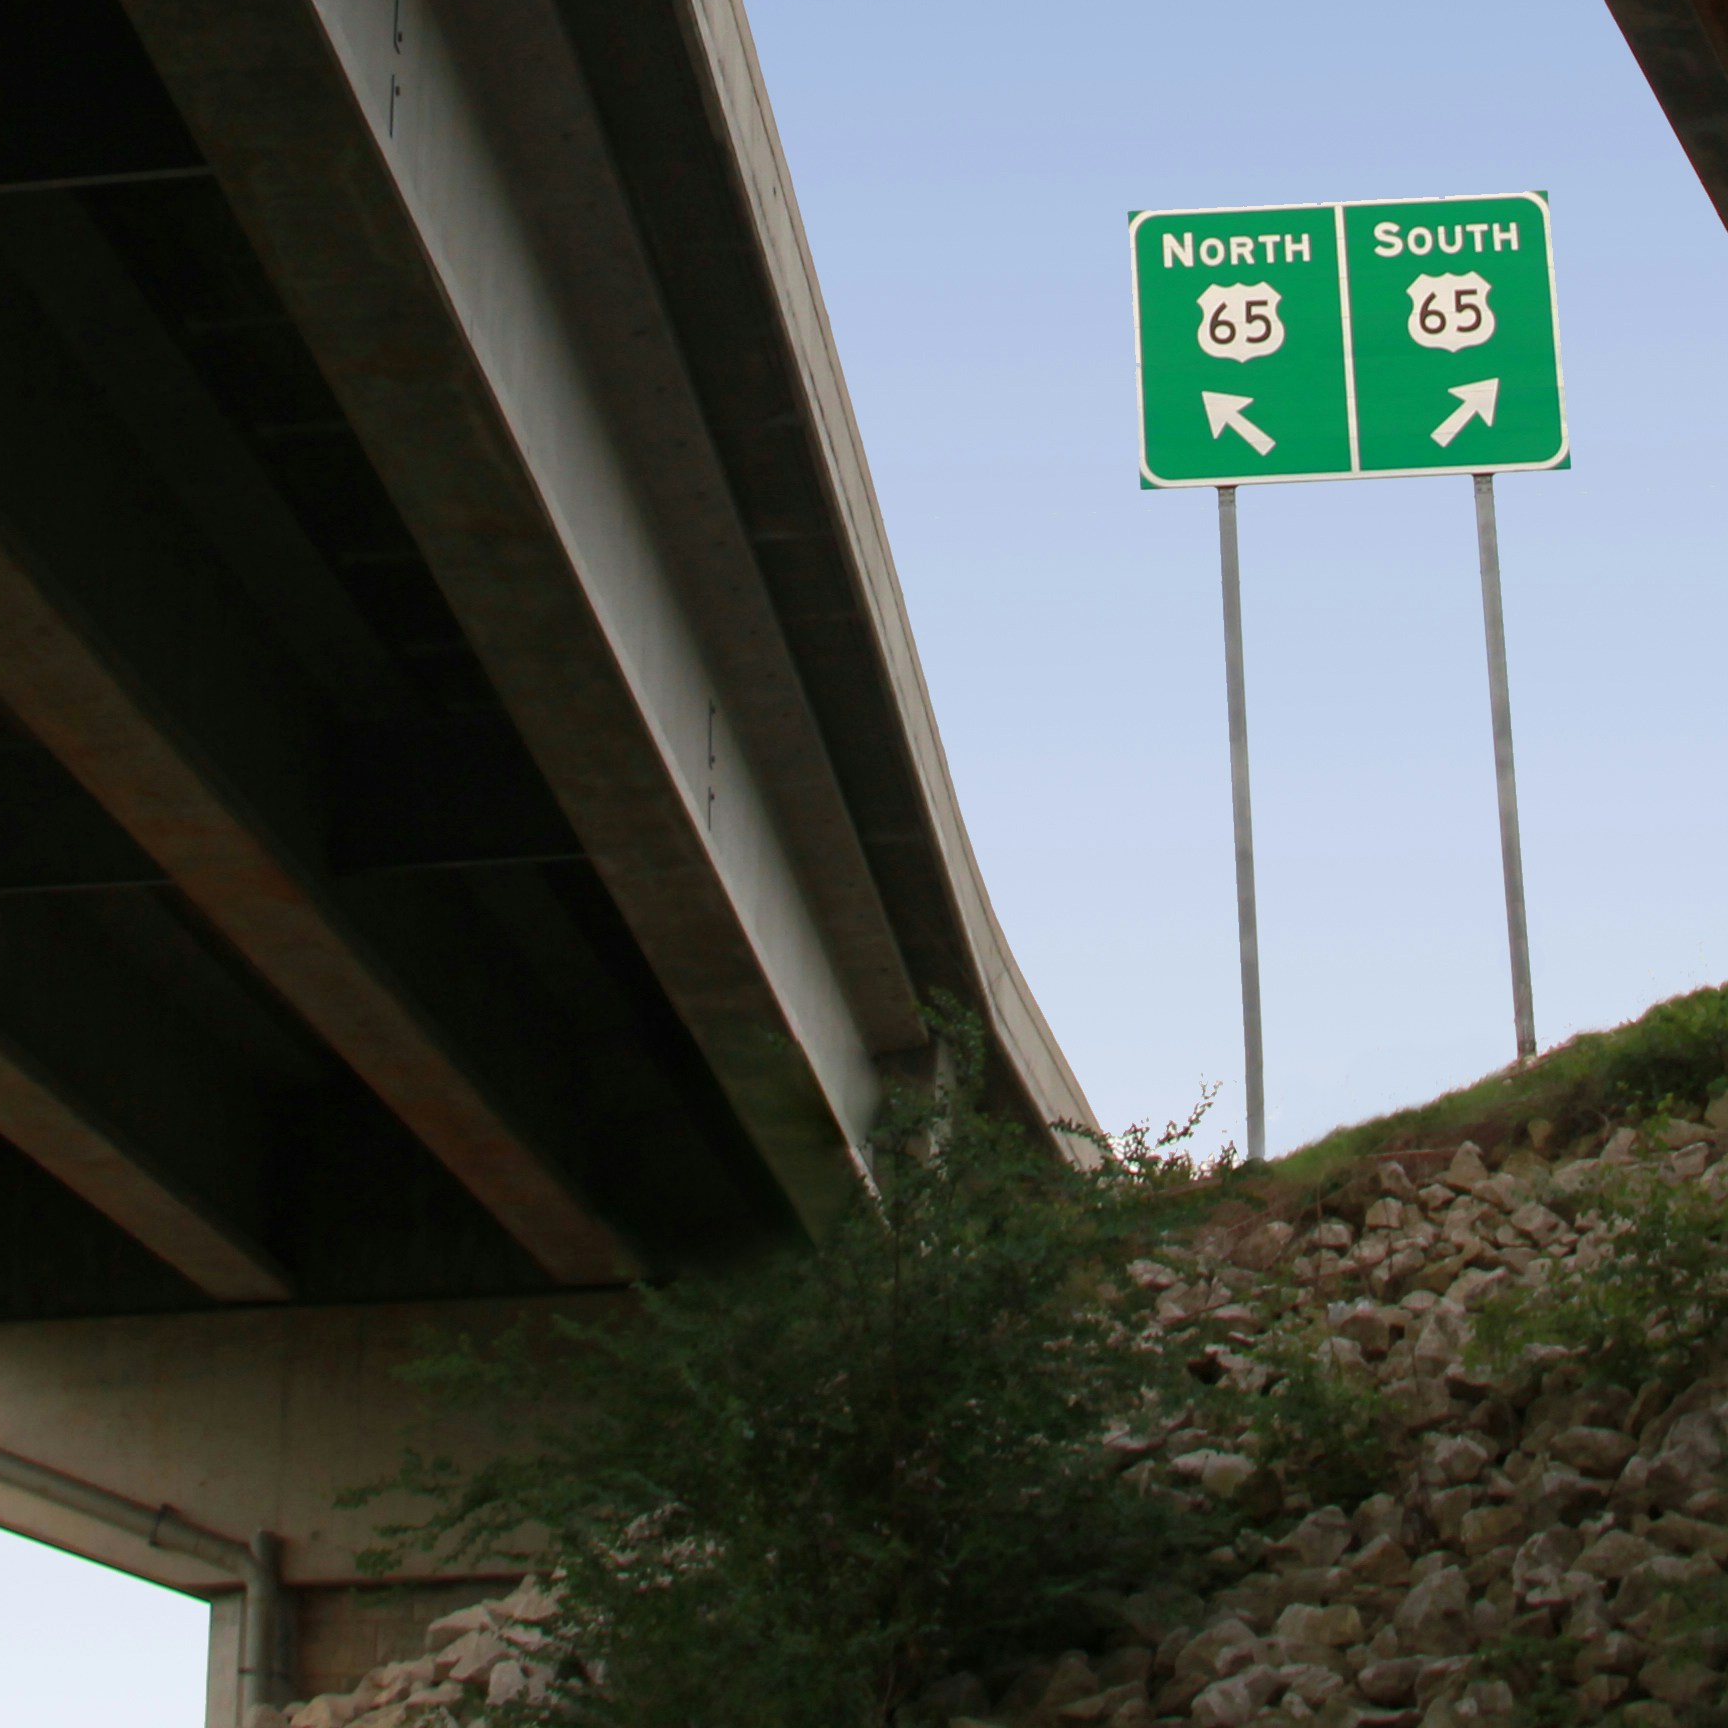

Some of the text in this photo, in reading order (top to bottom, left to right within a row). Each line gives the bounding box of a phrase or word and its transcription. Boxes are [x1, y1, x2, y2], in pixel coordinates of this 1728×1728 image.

[1162, 232, 1311, 268] NORTH
[1373, 221, 1519, 258] SOUTH
[1209, 300, 1272, 345] 65
[1419, 289, 1482, 335] 65
